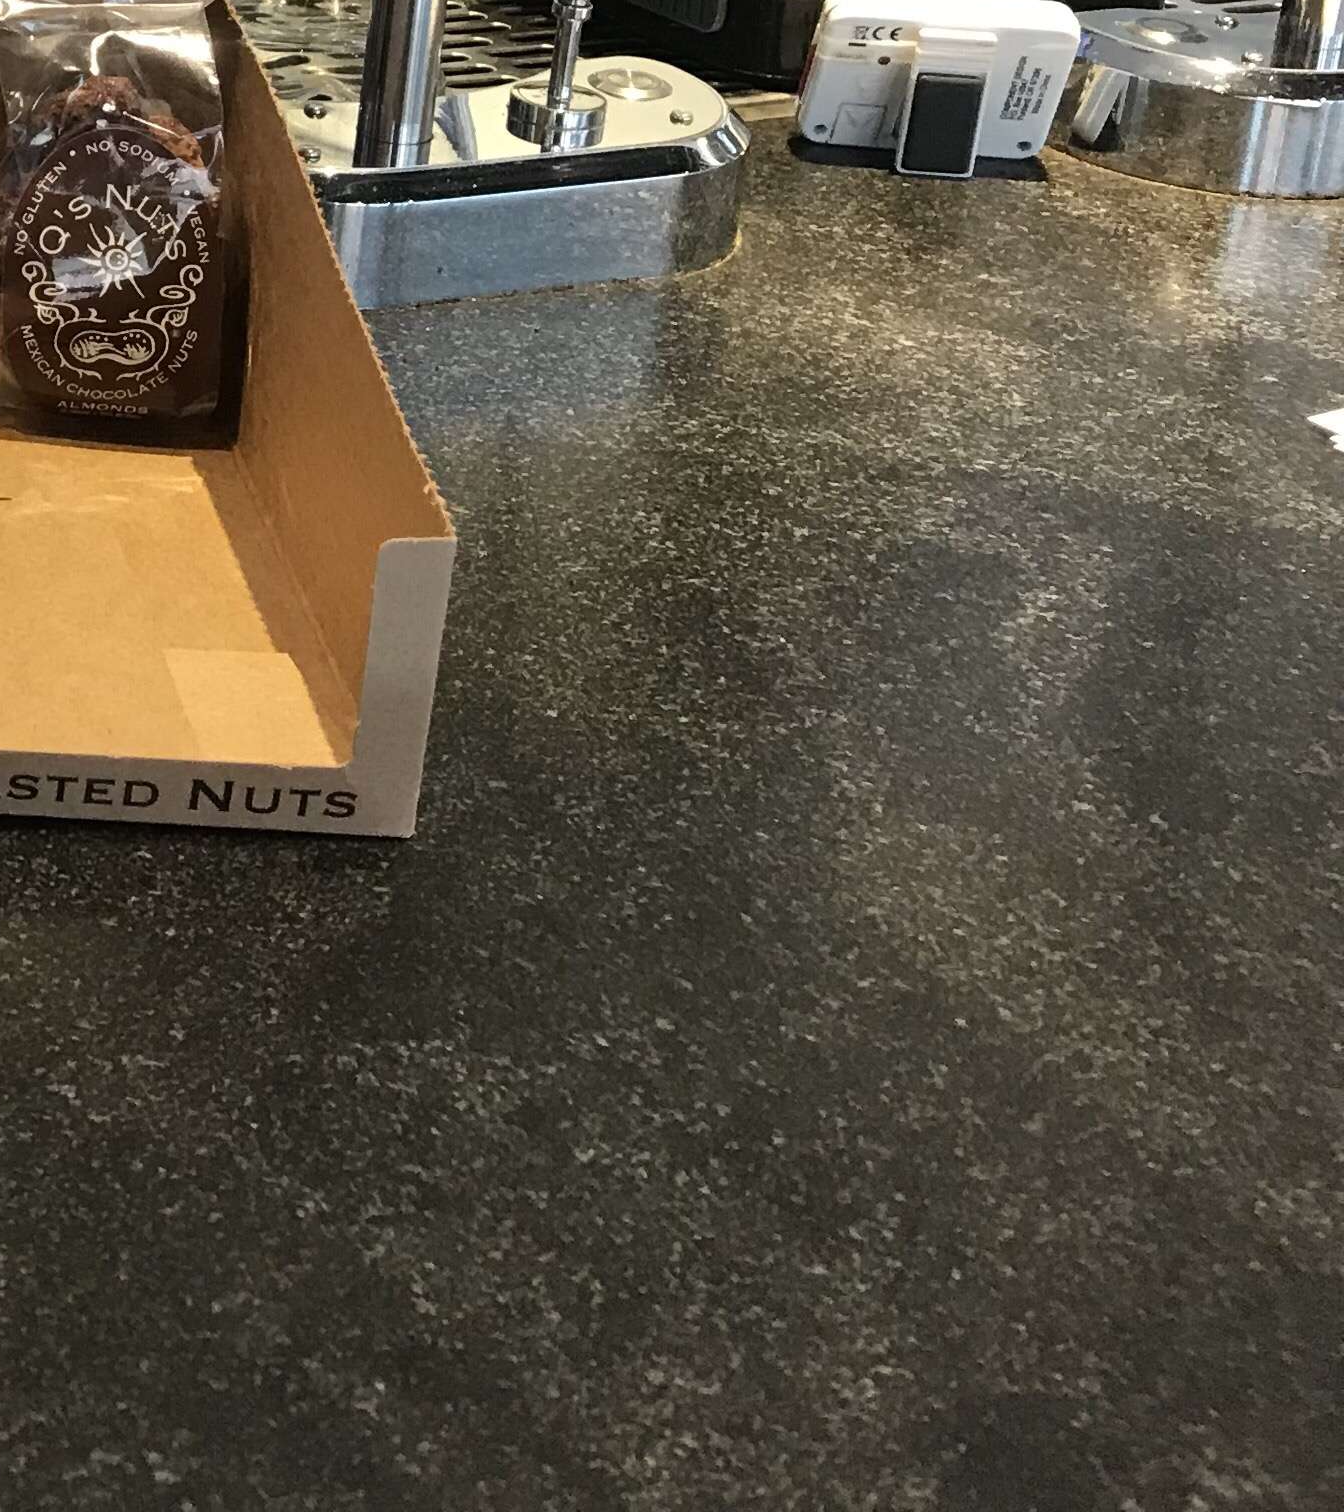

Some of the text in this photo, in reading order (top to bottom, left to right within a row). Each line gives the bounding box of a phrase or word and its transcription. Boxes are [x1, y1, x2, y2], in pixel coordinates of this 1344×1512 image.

[13, 140, 211, 264] NO GLUTEN NO SODIUM VEGAN
[38, 183, 188, 262] Q'S NUTS
[20, 323, 199, 401] MEXICAN CHOCOLATE NUTS
[56, 399, 149, 415] ALMONDS
[185, 778, 359, 820] NUTS
